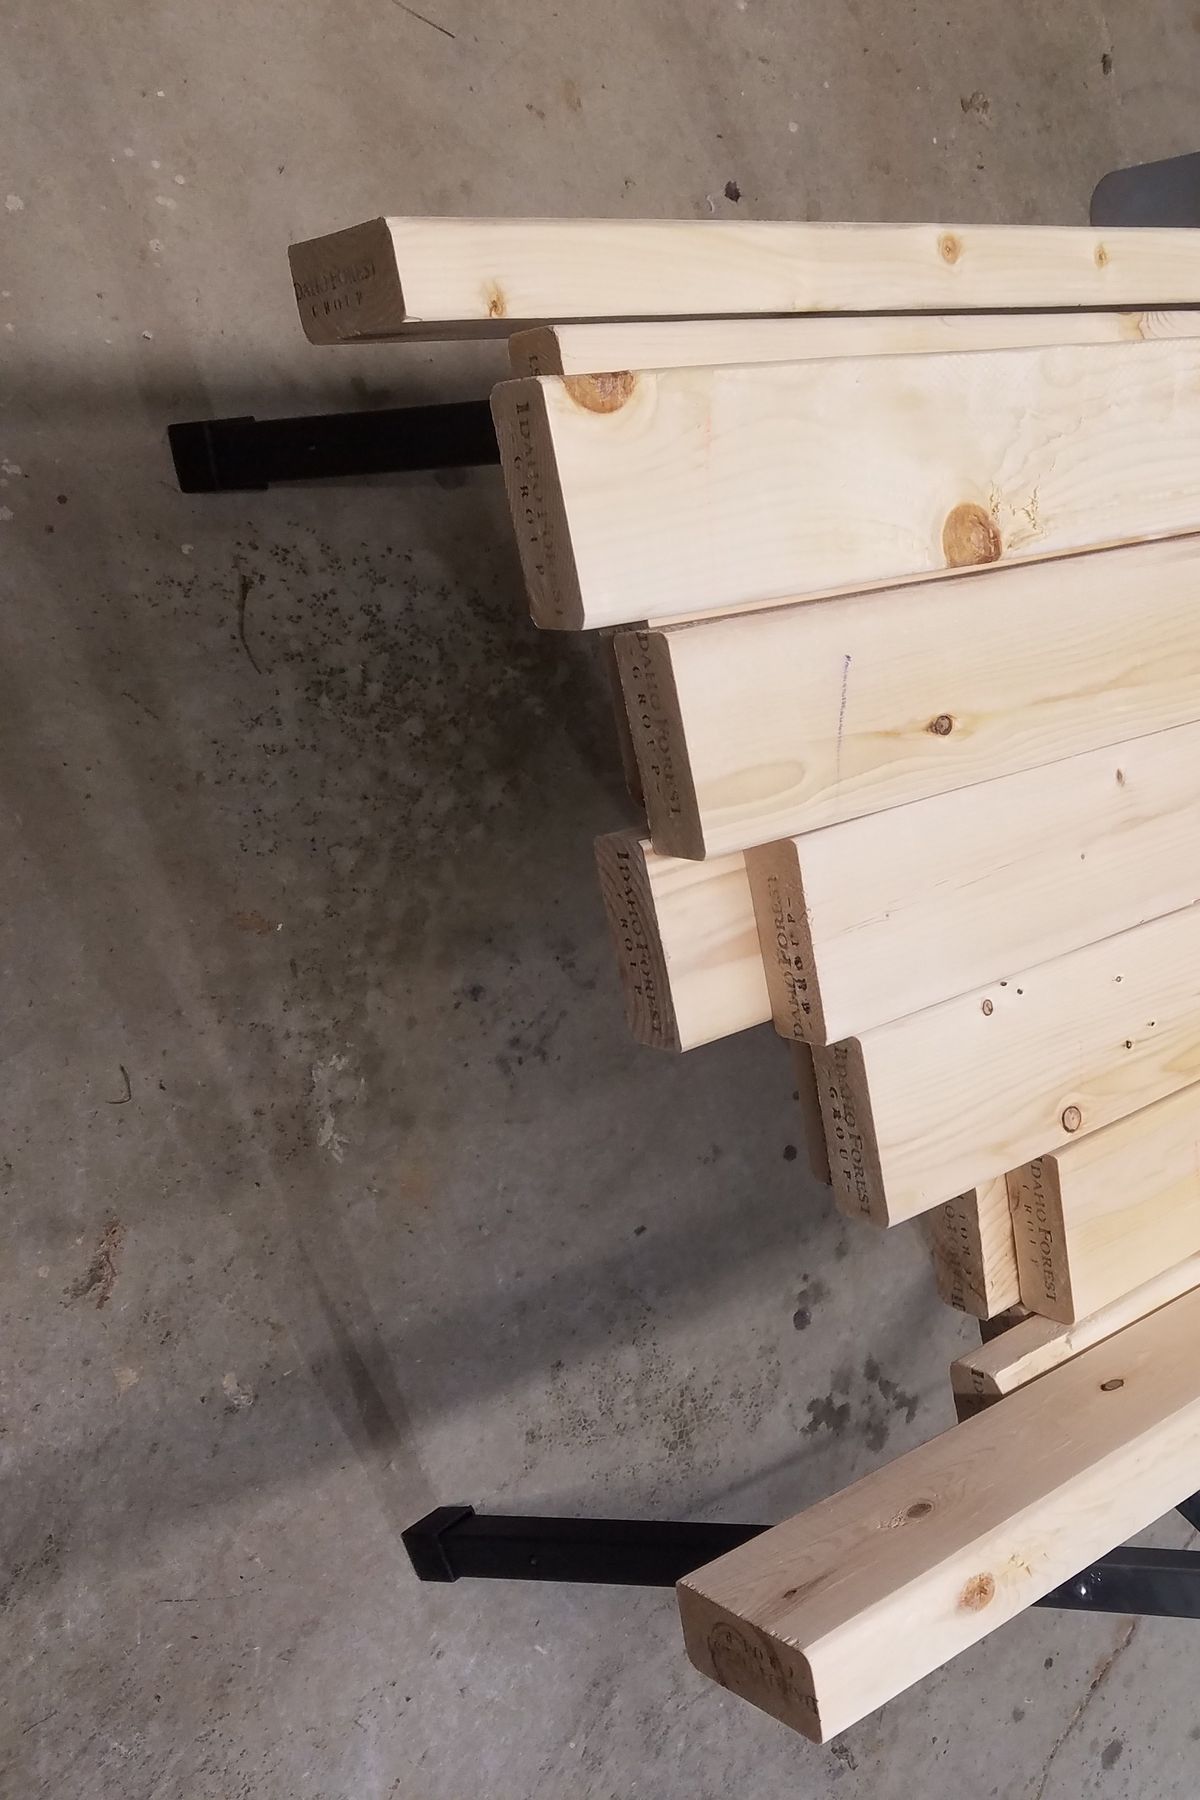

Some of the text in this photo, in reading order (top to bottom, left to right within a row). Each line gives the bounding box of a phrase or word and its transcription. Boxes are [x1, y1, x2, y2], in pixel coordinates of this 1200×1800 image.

[827, 1085, 853, 1182] GROUP
[848, 1129, 872, 1218] FOREST
[1037, 1226, 1058, 1304] FOREST
